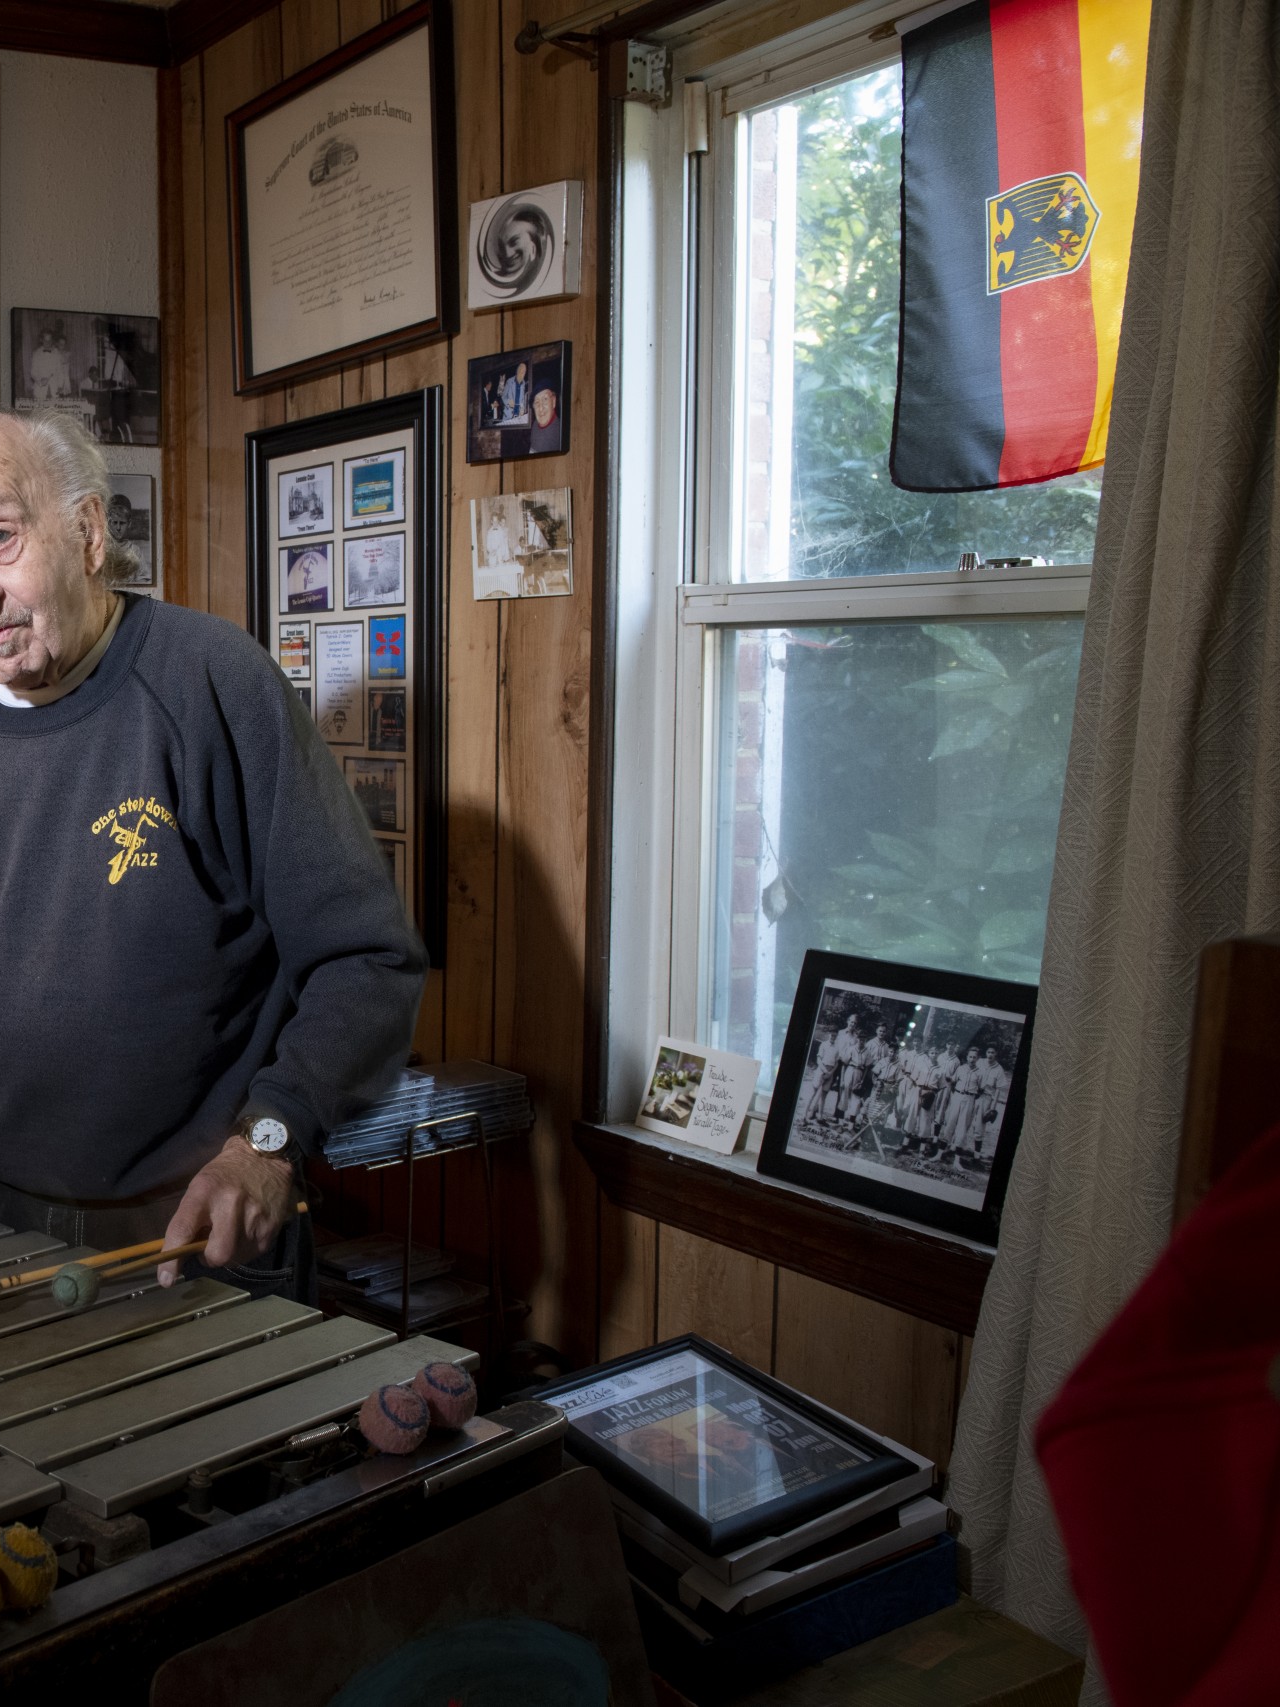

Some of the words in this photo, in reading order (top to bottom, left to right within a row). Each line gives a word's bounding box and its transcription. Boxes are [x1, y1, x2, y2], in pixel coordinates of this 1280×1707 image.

[327, 108, 348, 129] United
[350, 101, 372, 118] States
[373, 101, 381, 116] of
[381, 98, 412, 124] America
[118, 797, 145, 816] step
[145, 796, 177, 831] down
[601, 1399, 649, 1423] JAZZ
[646, 1387, 693, 1410] FORUM
[726, 1398, 761, 1414] Mon
[594, 1422, 634, 1440] Lennie
[762, 1419, 795, 1438] 07
[780, 1433, 820, 1450] 7pm
